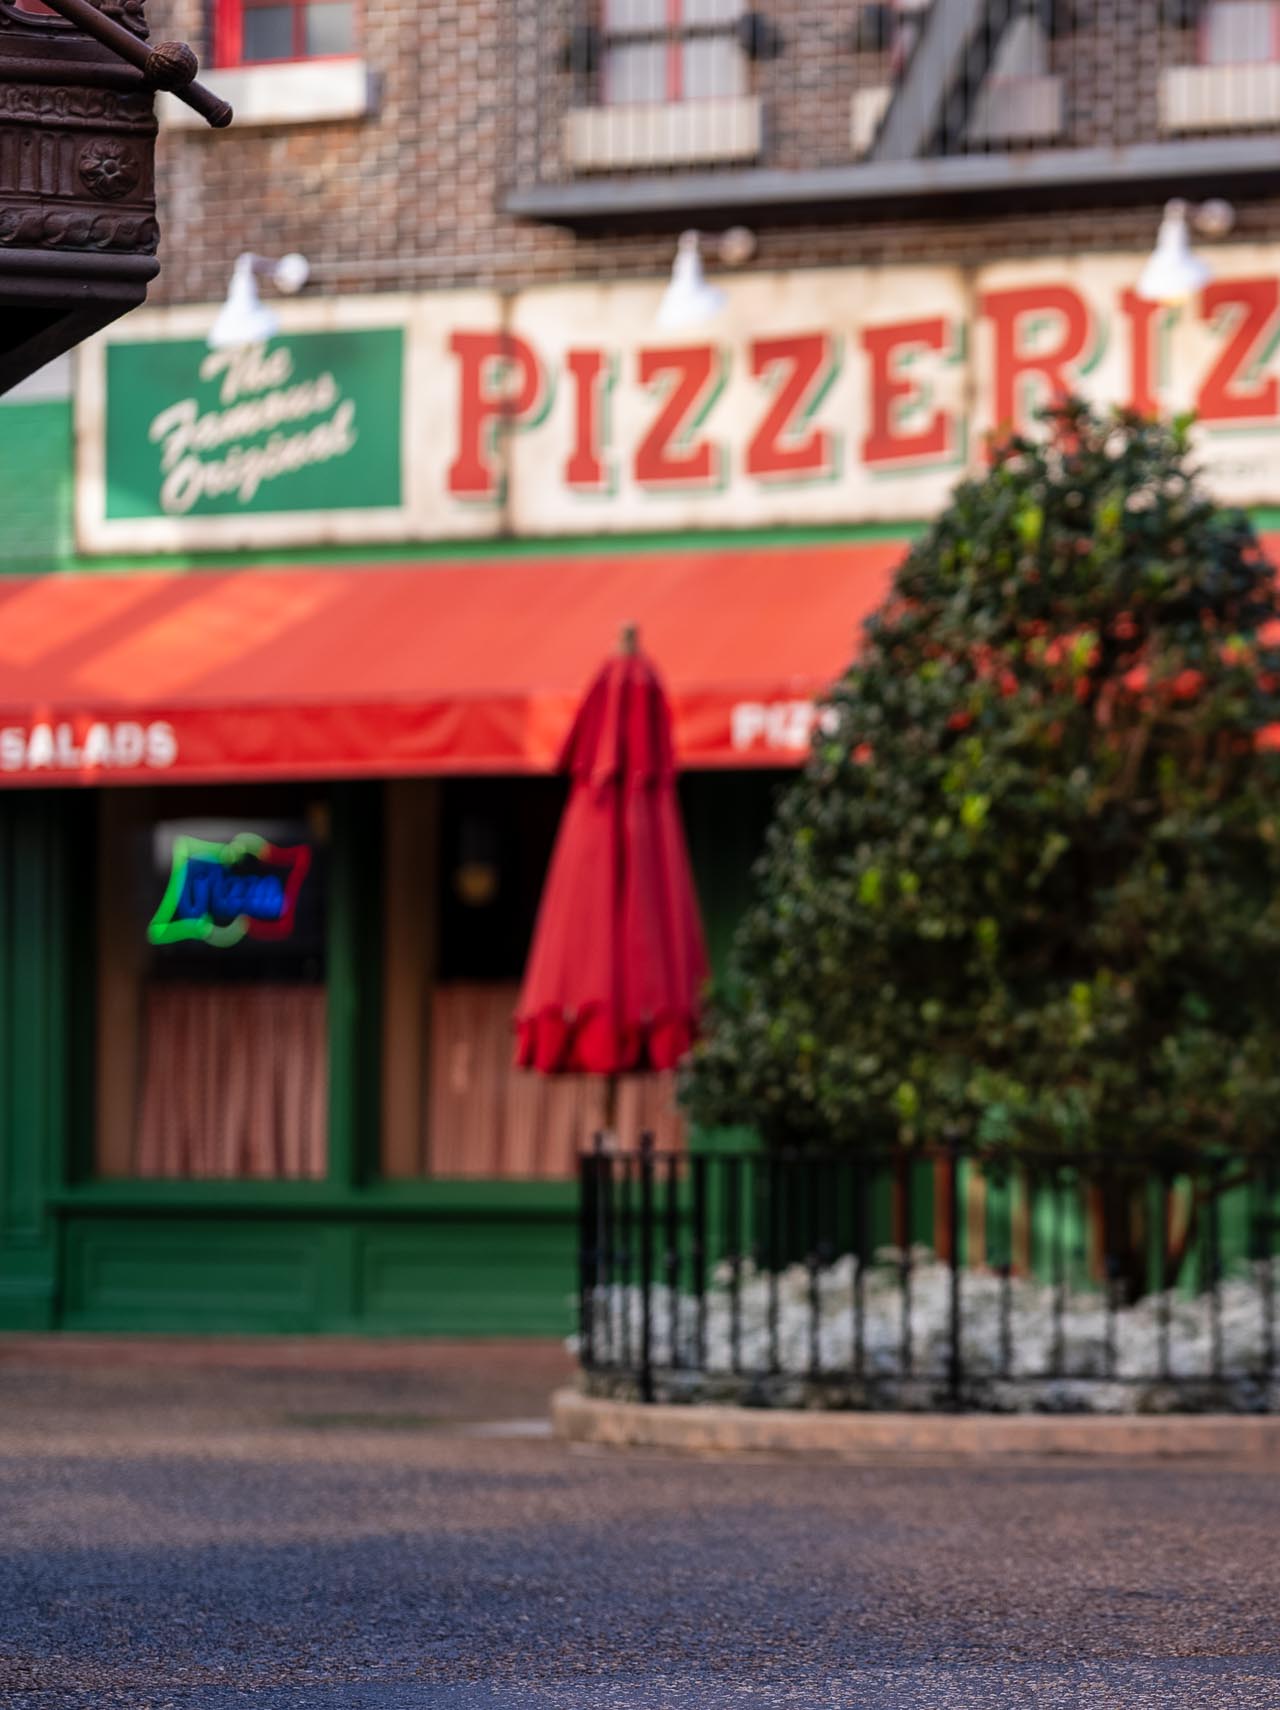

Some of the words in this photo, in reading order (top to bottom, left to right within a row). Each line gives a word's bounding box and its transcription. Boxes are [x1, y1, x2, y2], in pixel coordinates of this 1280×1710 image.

[199, 341, 293, 406] The
[148, 370, 340, 474] Famous
[159, 398, 357, 516] Original
[0, 720, 177, 772] SALADS
